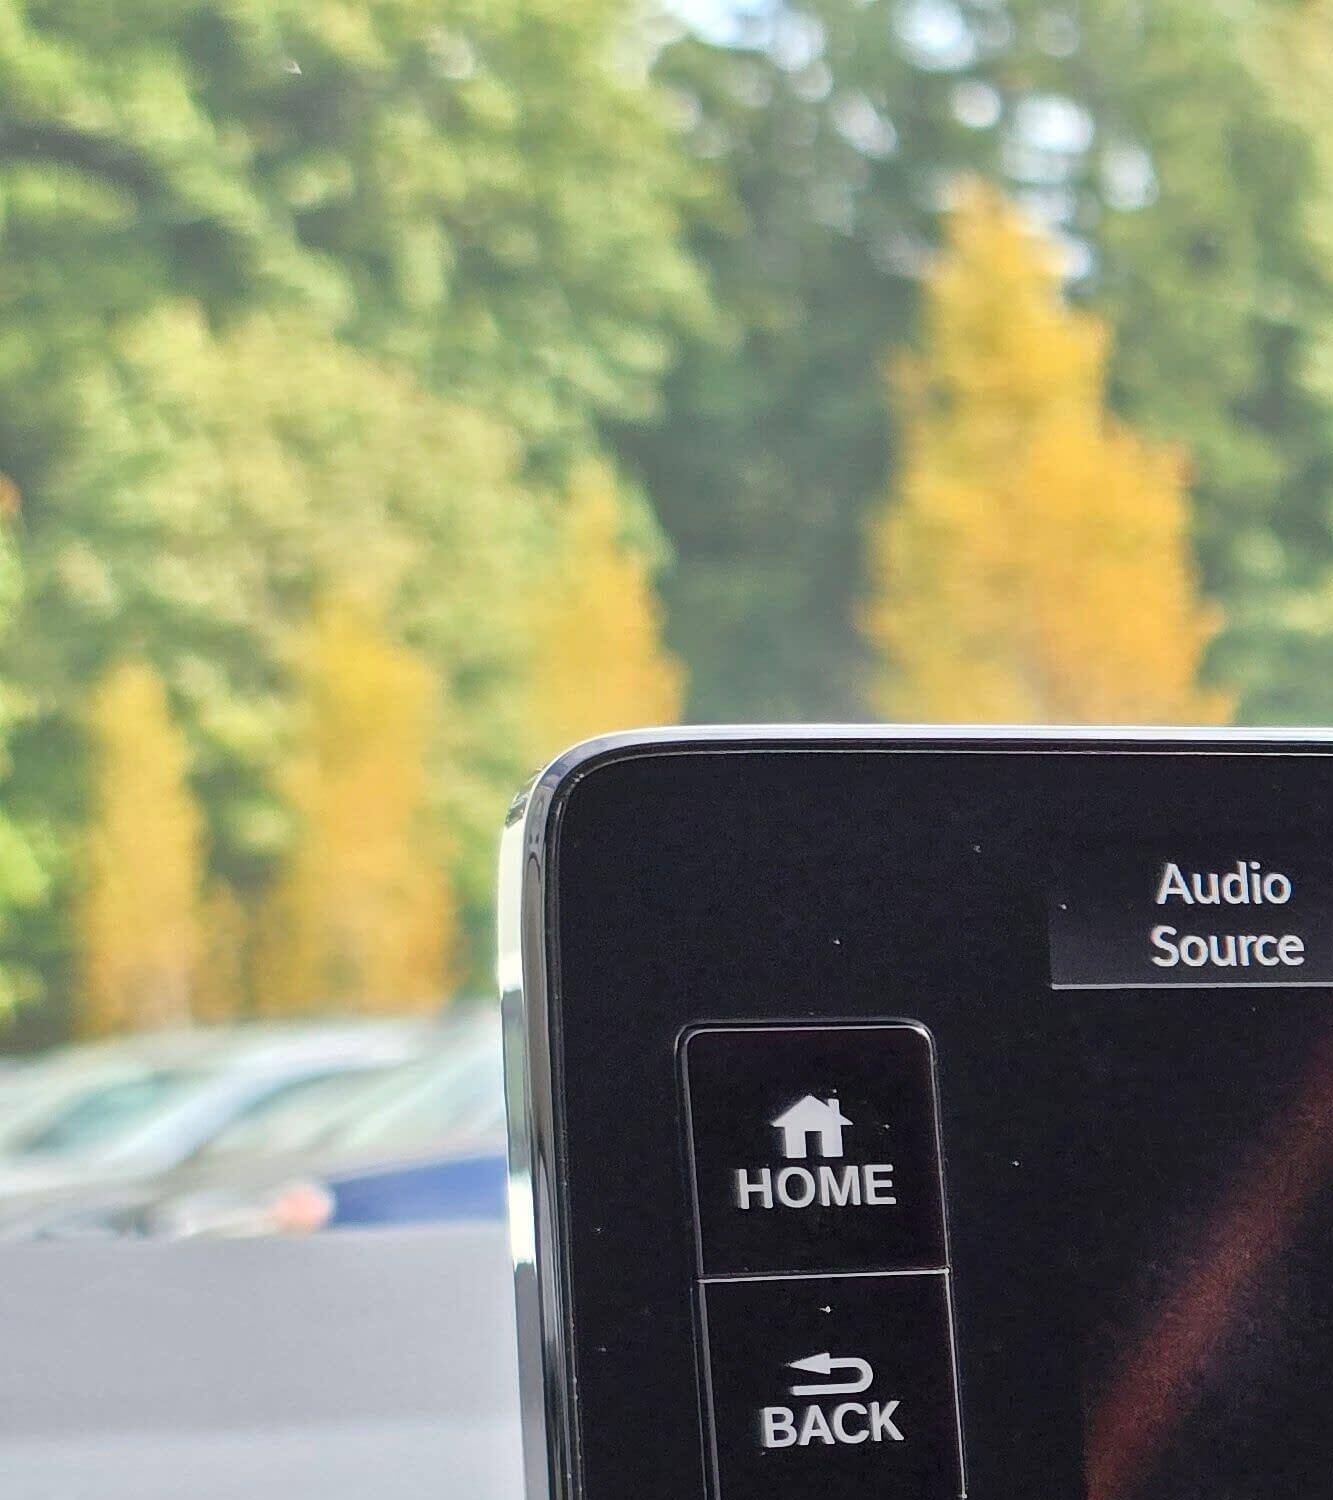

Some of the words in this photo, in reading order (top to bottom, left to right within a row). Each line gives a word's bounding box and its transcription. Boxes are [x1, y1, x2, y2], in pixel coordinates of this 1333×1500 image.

[1156, 860, 1292, 905] Audio
[1150, 925, 1305, 967] Source
[736, 1163, 897, 1210] HOME
[760, 1400, 905, 1449] BACK
